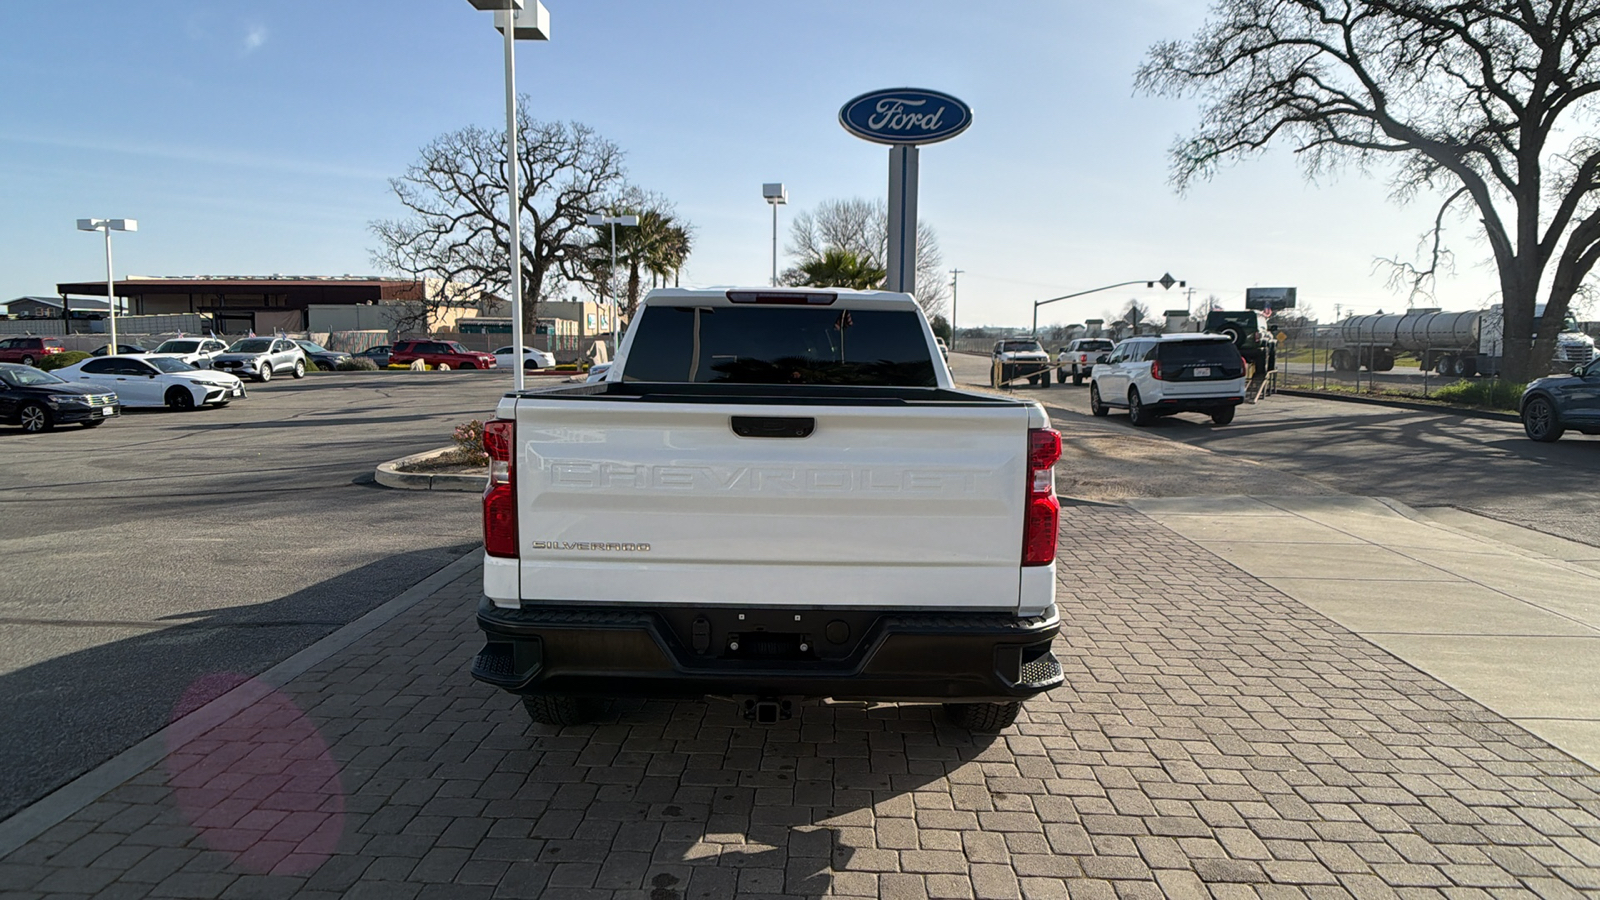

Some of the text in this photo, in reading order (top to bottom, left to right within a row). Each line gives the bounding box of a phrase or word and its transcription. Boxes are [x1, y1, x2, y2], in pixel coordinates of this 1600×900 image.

[868, 98, 946, 130] Ford
[550, 463, 993, 492] CHEVROLET
[532, 540, 652, 552] SILVERADO
